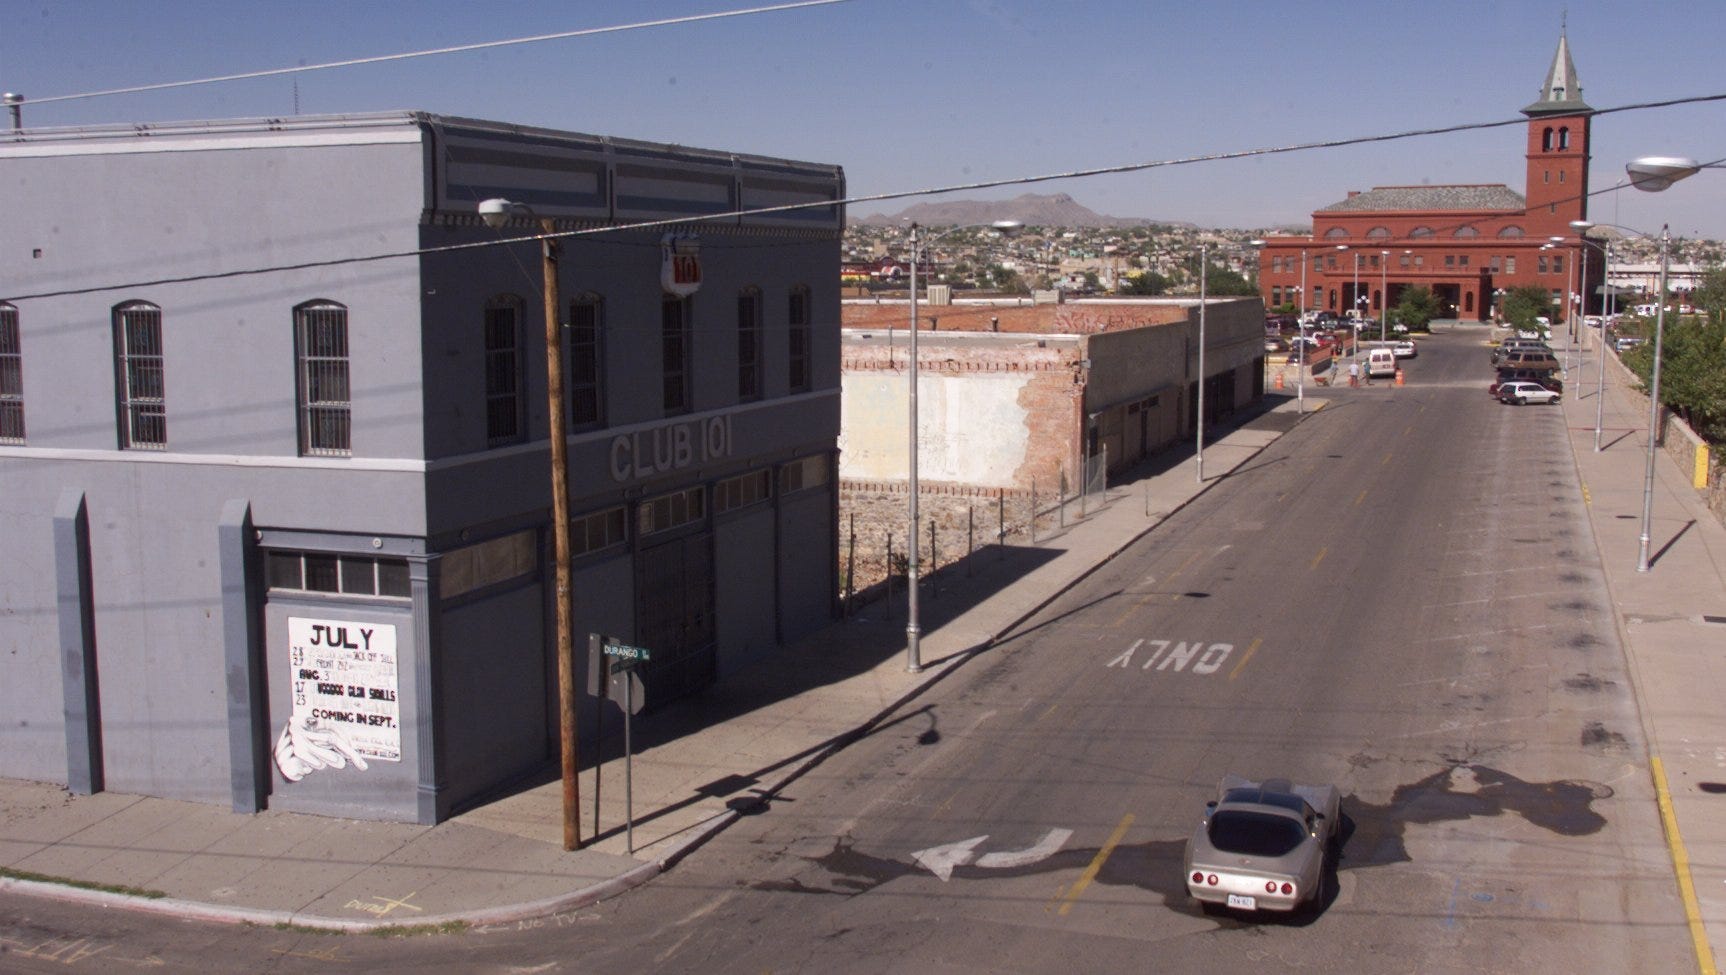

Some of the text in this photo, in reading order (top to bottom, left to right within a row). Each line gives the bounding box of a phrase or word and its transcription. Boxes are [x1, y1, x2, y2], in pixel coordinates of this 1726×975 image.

[610, 415, 733, 482] CLUB 101
[310, 624, 374, 650] JULY
[604, 645, 638, 658] DURANGO
[1106, 638, 1234, 674] ONLY
[312, 708, 397, 729] COMING IN SEPT.
